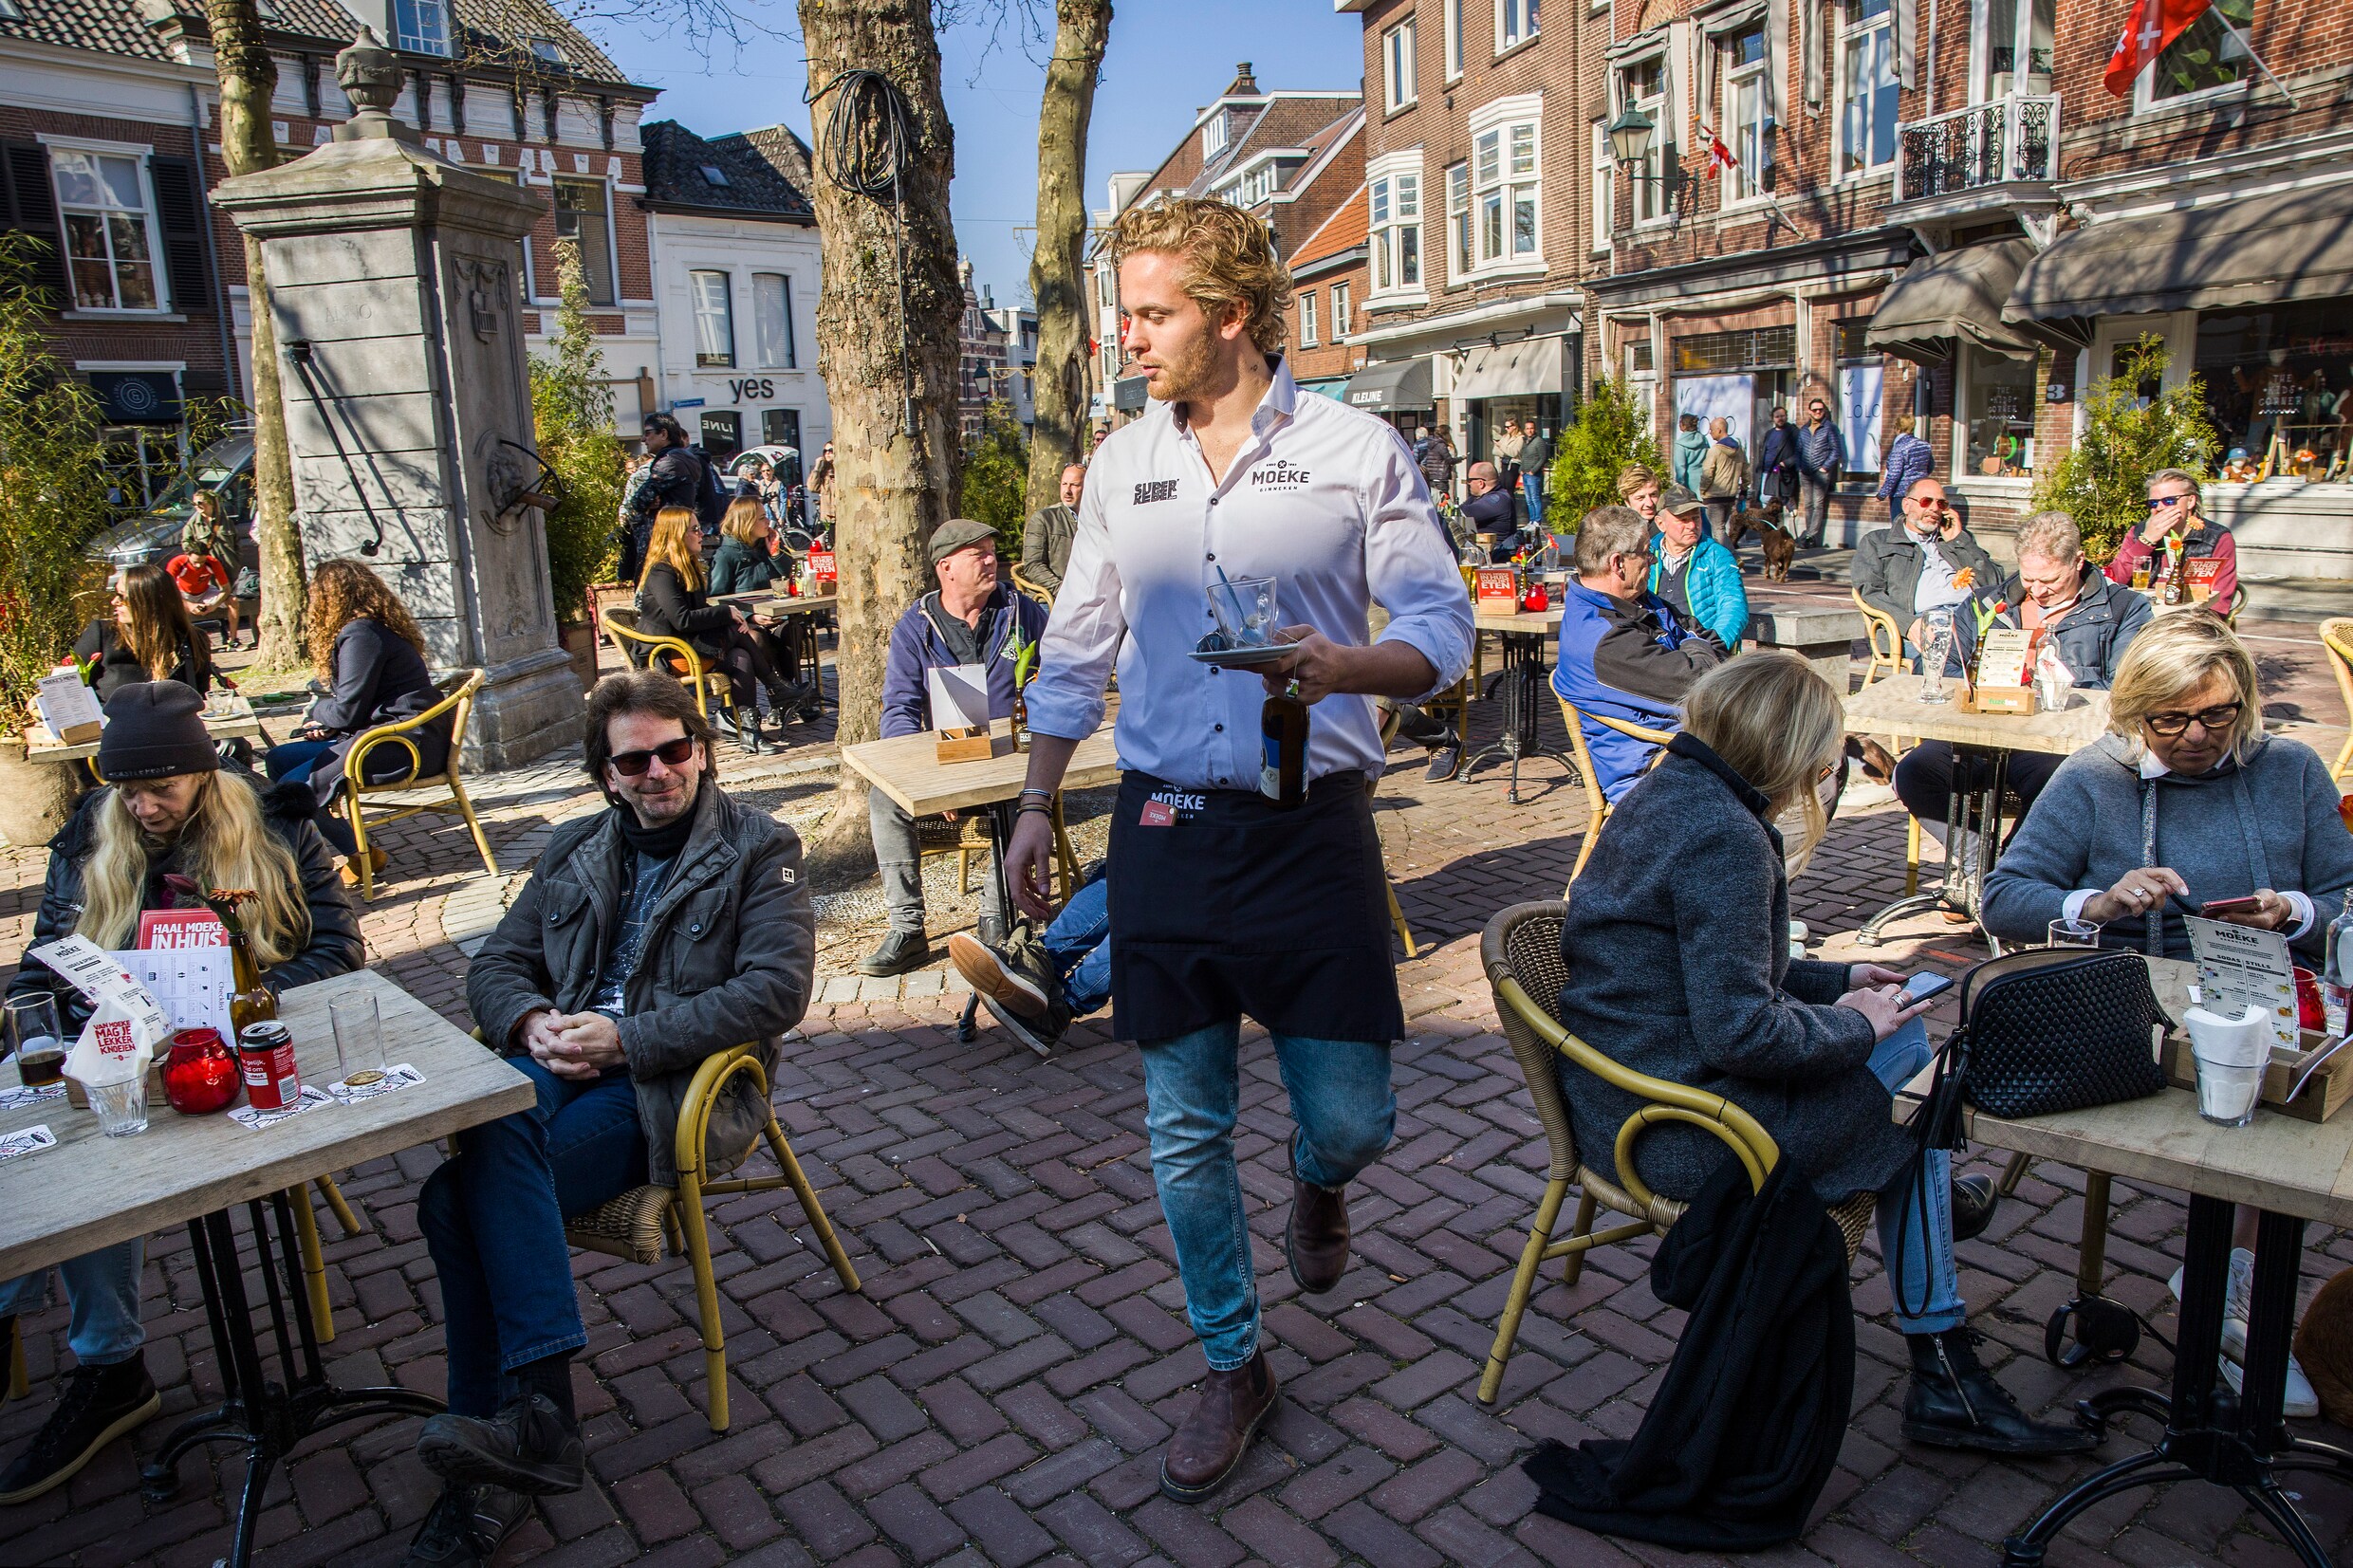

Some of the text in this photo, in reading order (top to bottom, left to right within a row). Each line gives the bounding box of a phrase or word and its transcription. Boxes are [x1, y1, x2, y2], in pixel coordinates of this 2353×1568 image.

[2272, 374, 2292, 382] THE
[729, 378, 774, 404] yes
[2047, 384, 2065, 398] 3
[2268, 385, 2296, 395] KIDS
[2258, 397, 2303, 406] CORNER
[1847, 403, 1881, 418] LOLO
[1251, 470, 1310, 485] MOEKE
[1135, 480, 1177, 495] SUPER
[1151, 792, 1206, 810] MOEKE
[153, 921, 224, 934] HAAL MOEKE
[152, 932, 222, 950] IN HUIS
[2214, 930, 2259, 945] MOEKE
[54, 945, 82, 958] MOEKE
[2216, 954, 2241, 963] SODAS
[2245, 960, 2271, 969] STILLS
[95, 1026, 131, 1039] MAG JE
[98, 1036, 133, 1047] LEKKER
[101, 1044, 136, 1055] KNOEIEN
